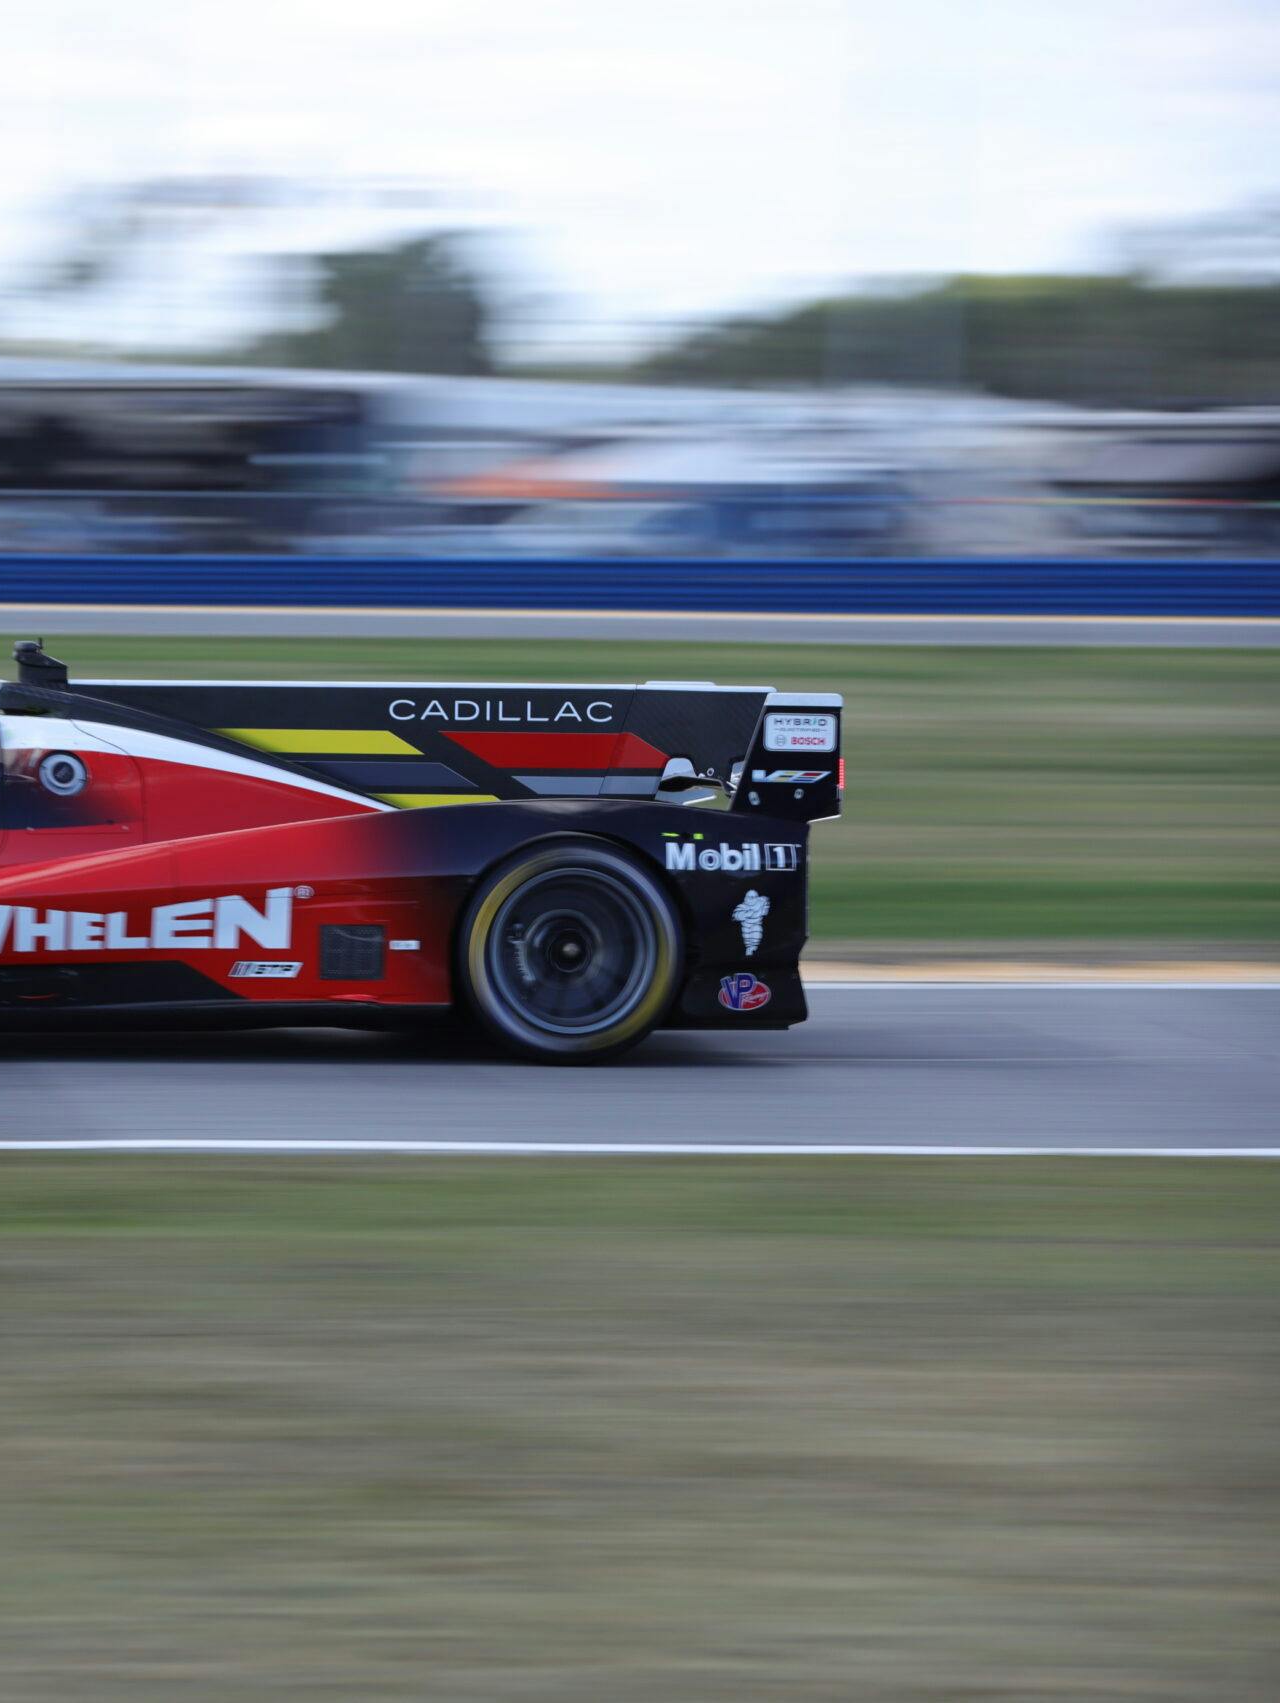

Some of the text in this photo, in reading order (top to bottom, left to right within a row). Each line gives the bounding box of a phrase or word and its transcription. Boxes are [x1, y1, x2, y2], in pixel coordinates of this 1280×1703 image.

[388, 699, 613, 723] CADILLAC
[790, 736, 826, 746] BOSCH
[665, 842, 761, 871] Mobil
[720, 972, 758, 1010] VP
